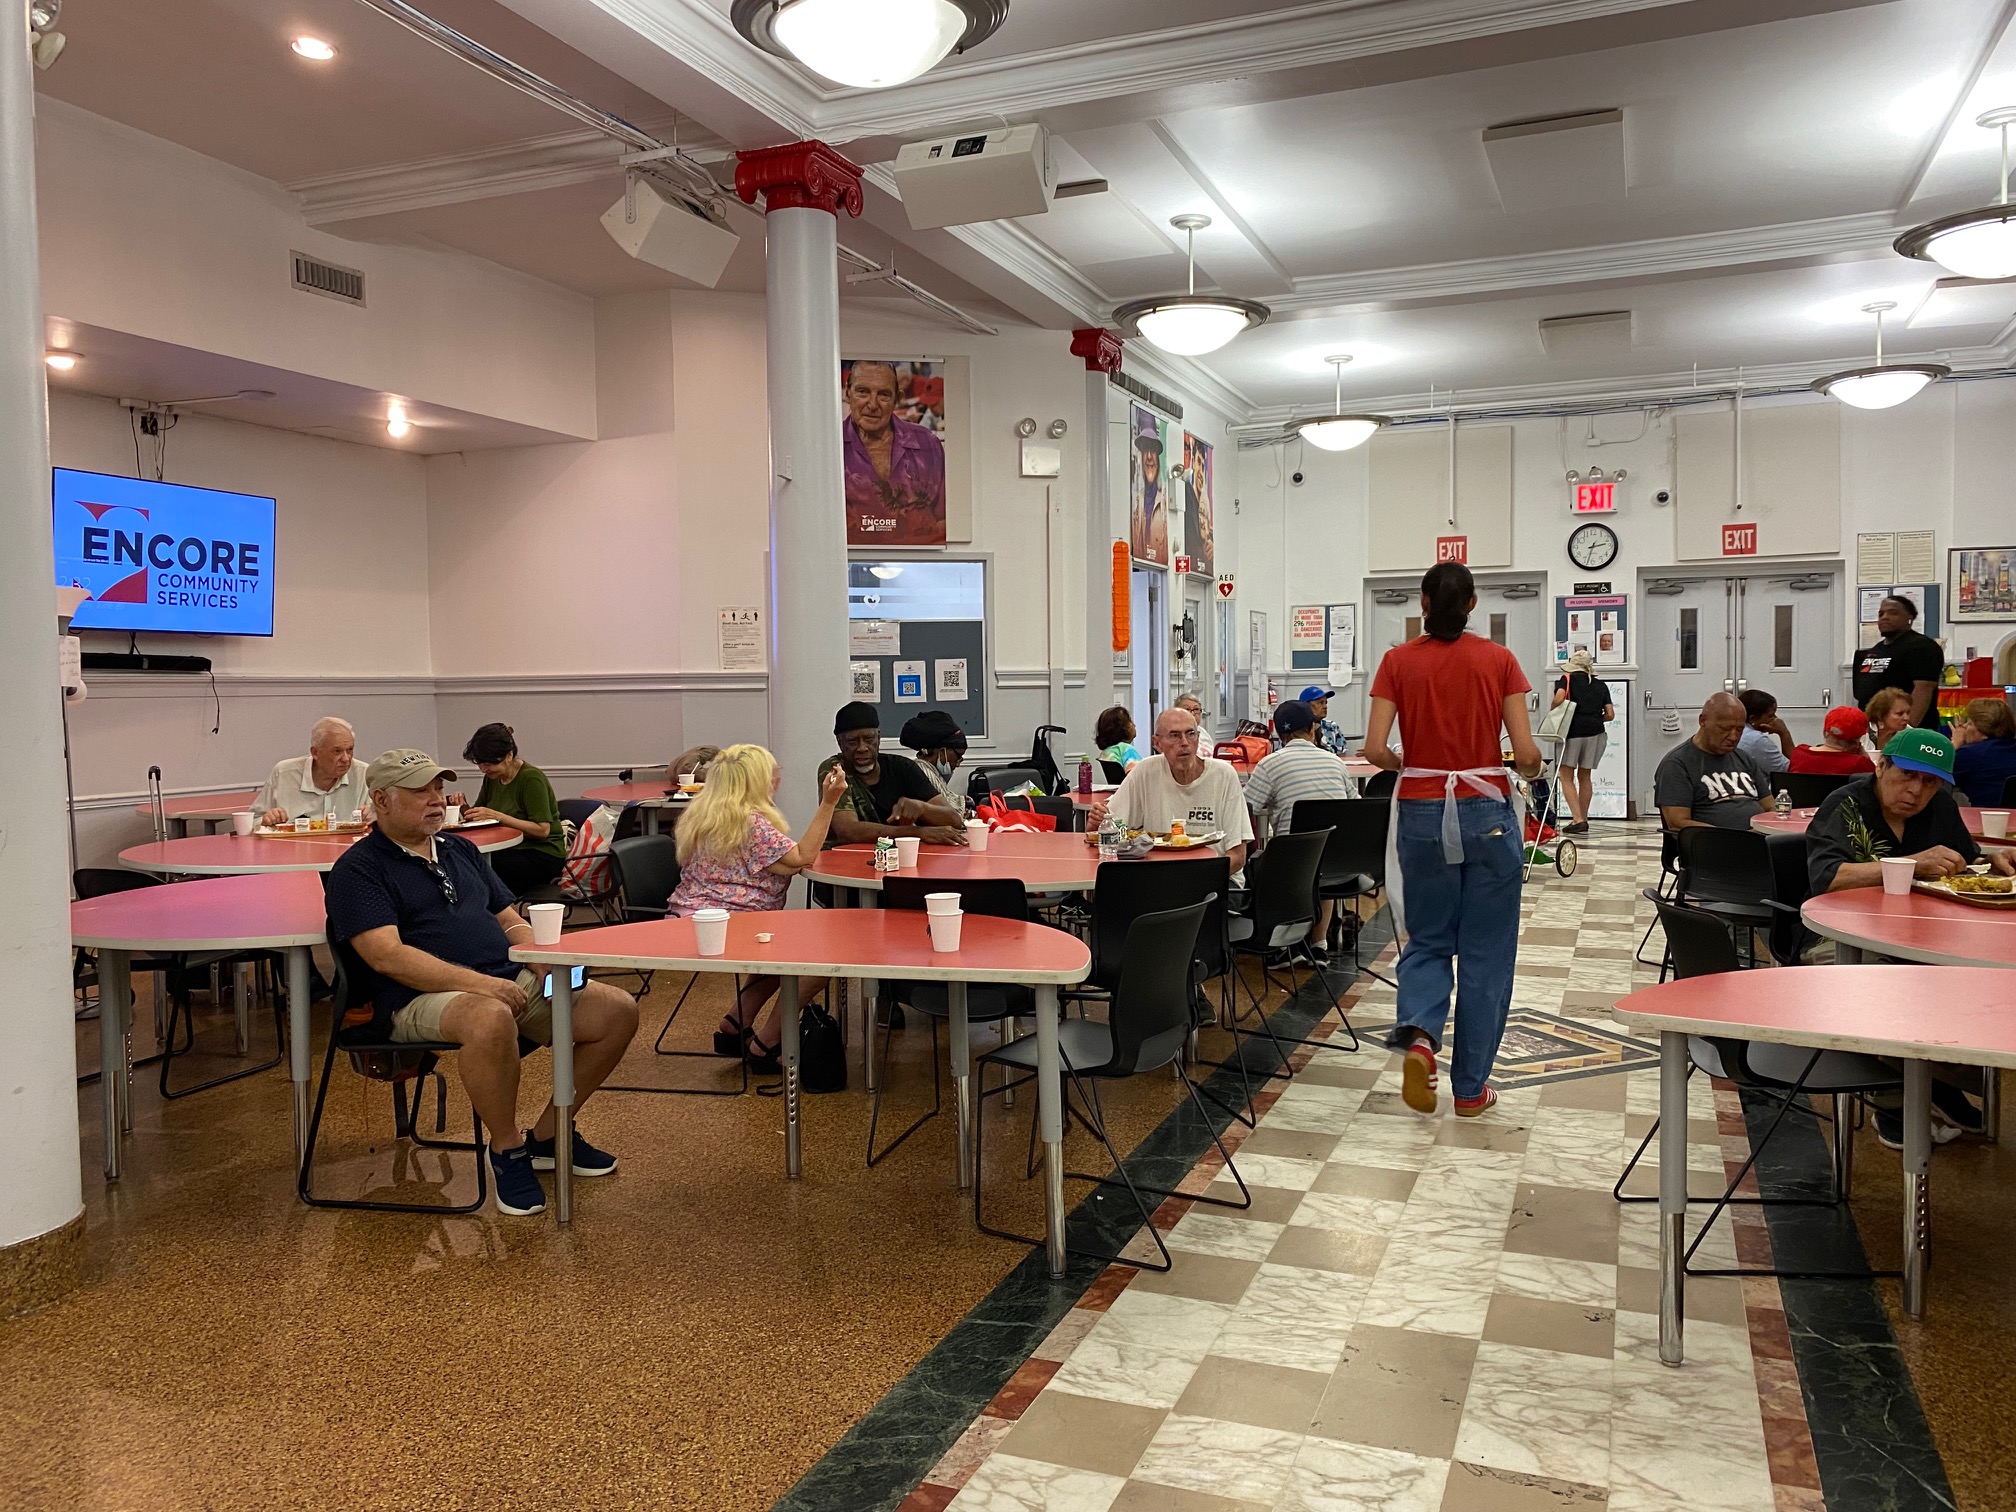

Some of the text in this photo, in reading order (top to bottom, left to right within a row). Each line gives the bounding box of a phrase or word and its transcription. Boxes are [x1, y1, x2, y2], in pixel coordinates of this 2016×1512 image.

[1578, 484, 1614, 510] EXIT
[1725, 530, 1754, 549] EXIT
[83, 526, 260, 577] ENCORE
[1439, 542, 1464, 560] EXIT
[158, 573, 259, 594] COMMUNITY
[157, 590, 238, 609] SERVICES
[1920, 744, 1943, 756] POLO
[400, 756, 415, 765] NEW
[1700, 772, 1758, 800] NYC
[1189, 811, 1213, 820] PCSC
